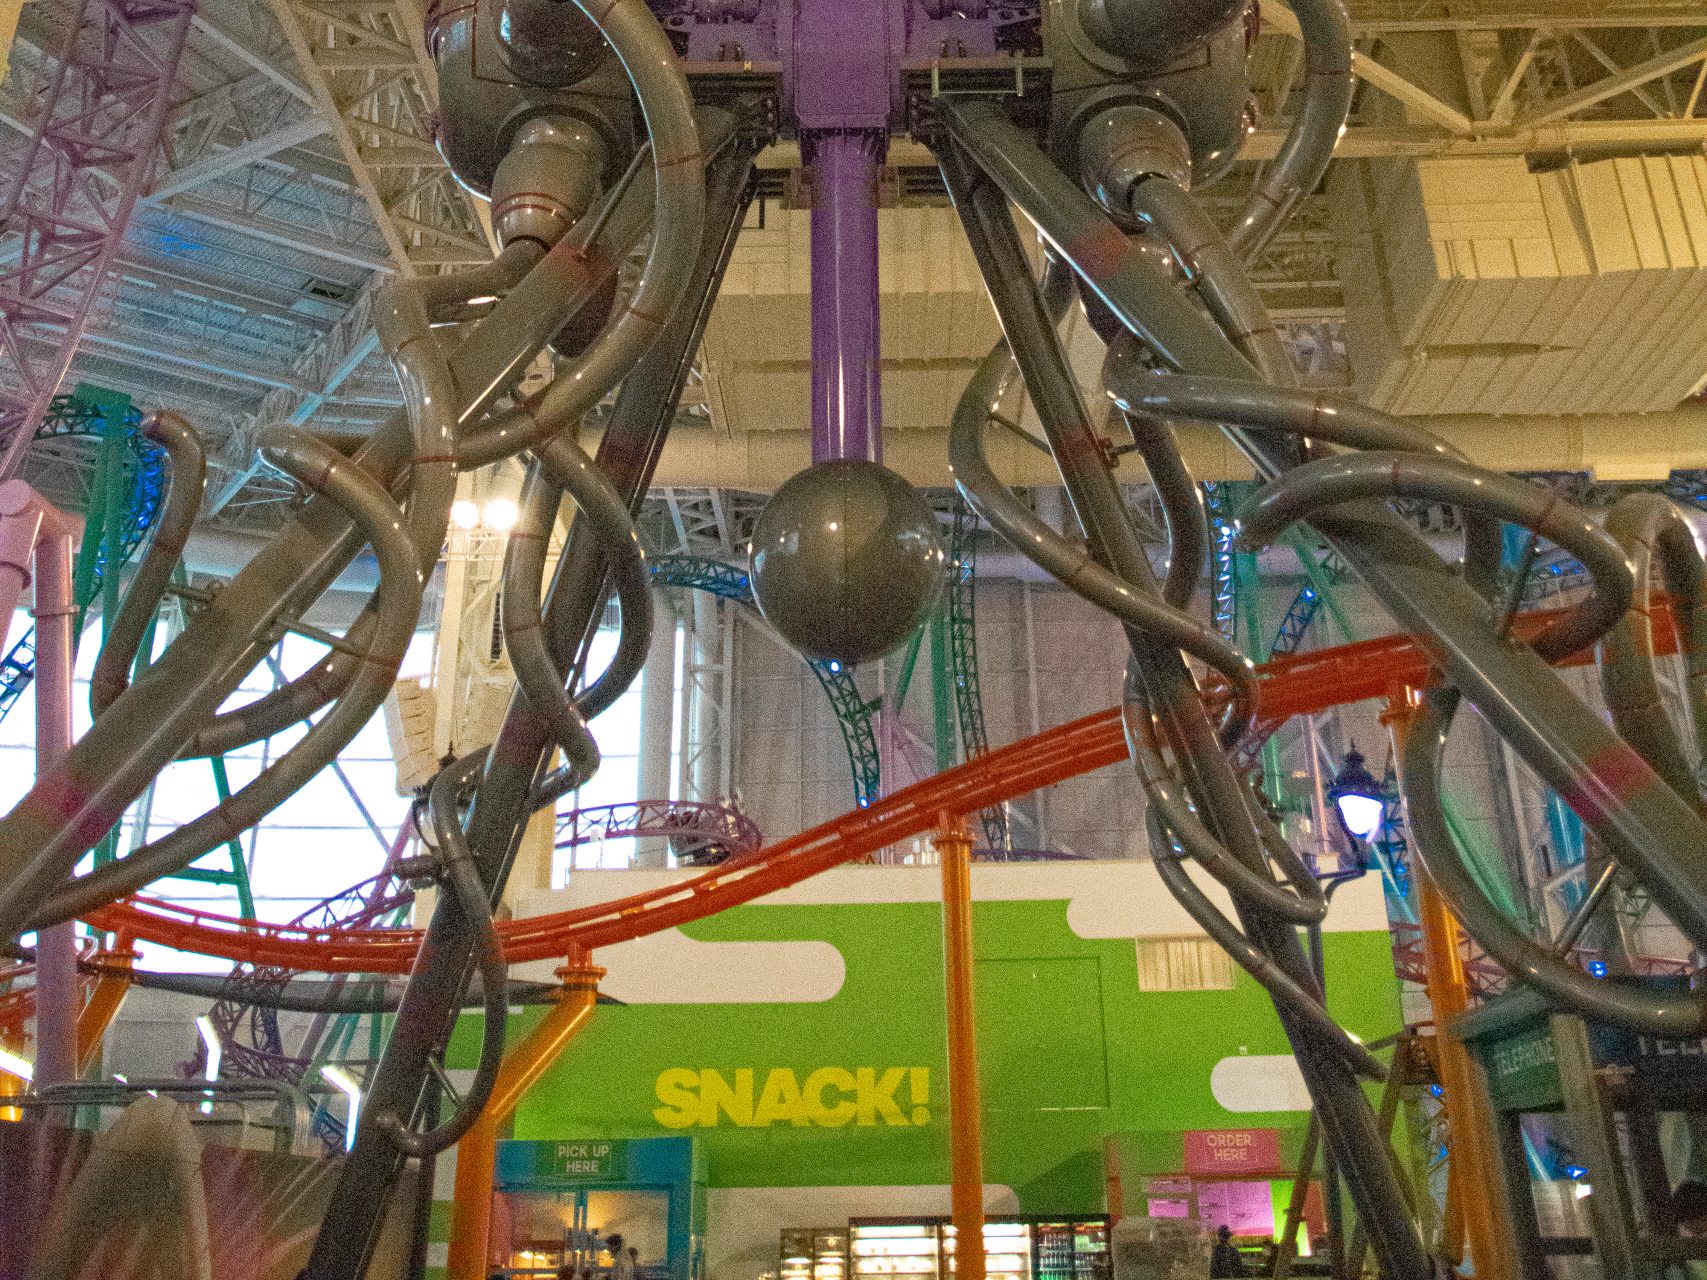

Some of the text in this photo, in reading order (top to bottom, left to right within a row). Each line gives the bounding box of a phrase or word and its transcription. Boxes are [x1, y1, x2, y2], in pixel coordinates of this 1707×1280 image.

[653, 1066, 931, 1128] SNACK!
[1207, 1133, 1251, 1147] ORDER
[558, 1144, 609, 1158] PICK UP
[1214, 1148, 1247, 1161] HERE
[566, 1159, 599, 1173] HERE
